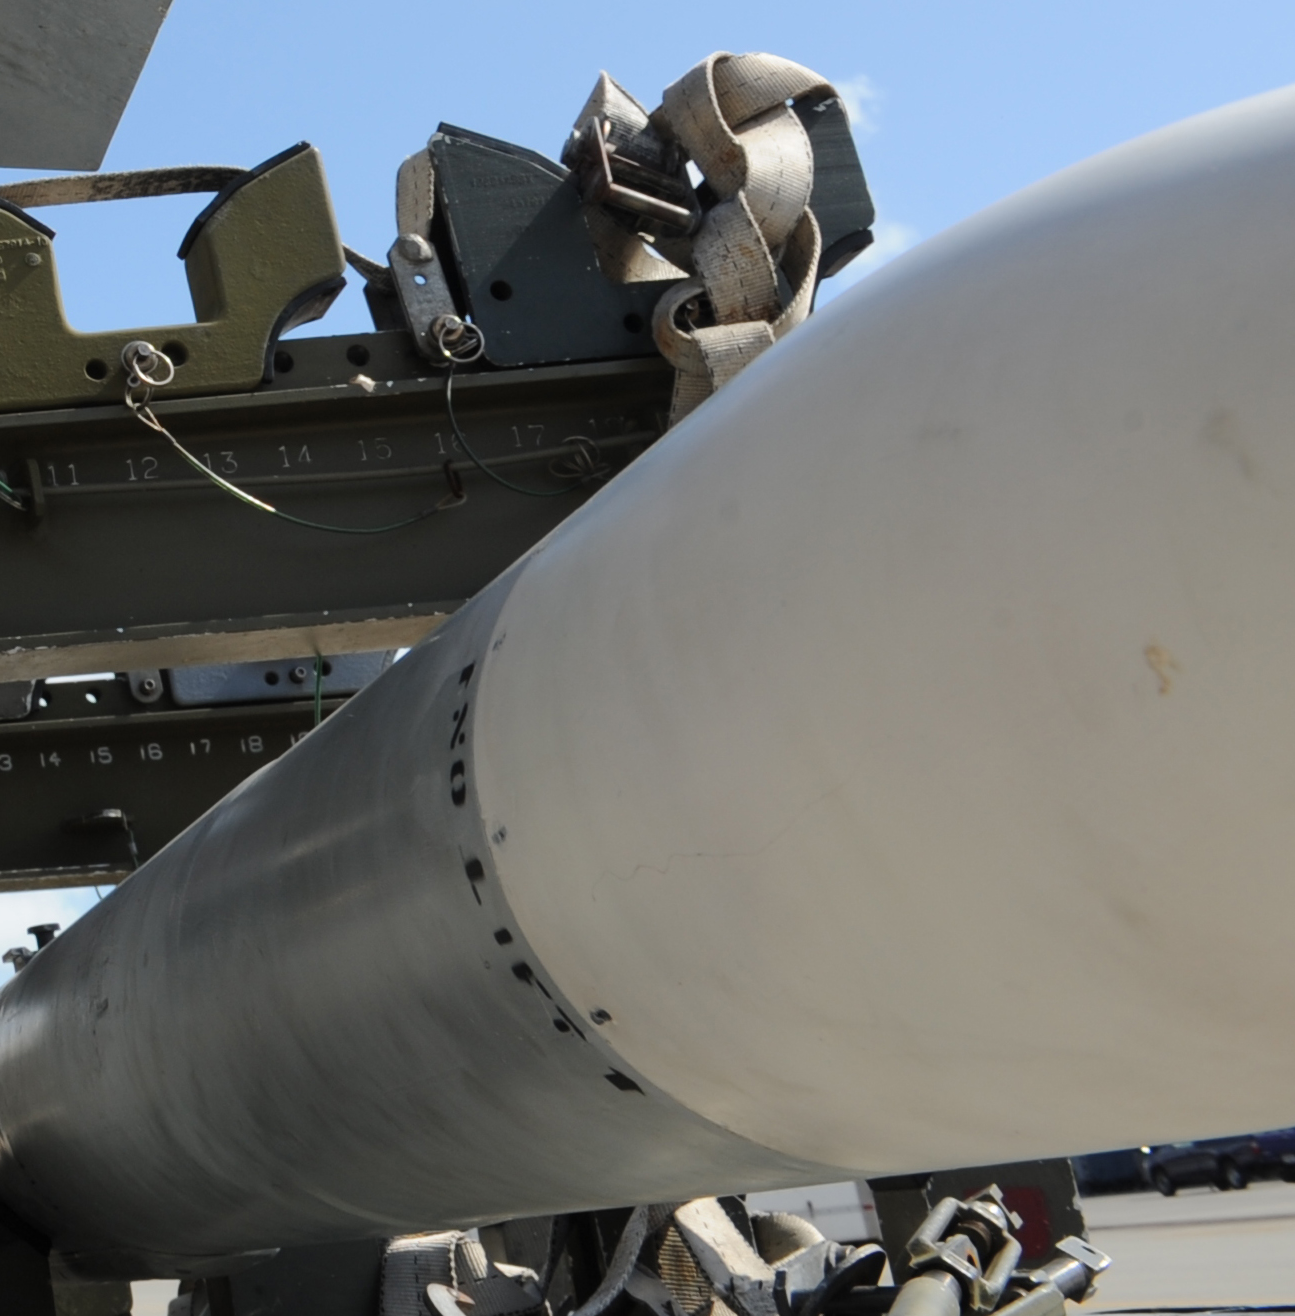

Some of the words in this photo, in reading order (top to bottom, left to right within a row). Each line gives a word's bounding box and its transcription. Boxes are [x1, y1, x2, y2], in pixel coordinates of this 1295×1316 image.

[48, 463, 80, 487] 11
[125, 456, 159, 481] 12
[203, 451, 238, 474] 13
[278, 444, 311, 469] 14
[357, 437, 393, 461] 15
[511, 424, 545, 447] 17
[38, 749, 63, 769] 14
[89, 746, 115, 766] 15
[139, 743, 164, 761] 16
[189, 738, 212, 755] 17
[240, 735, 264, 753] 18
